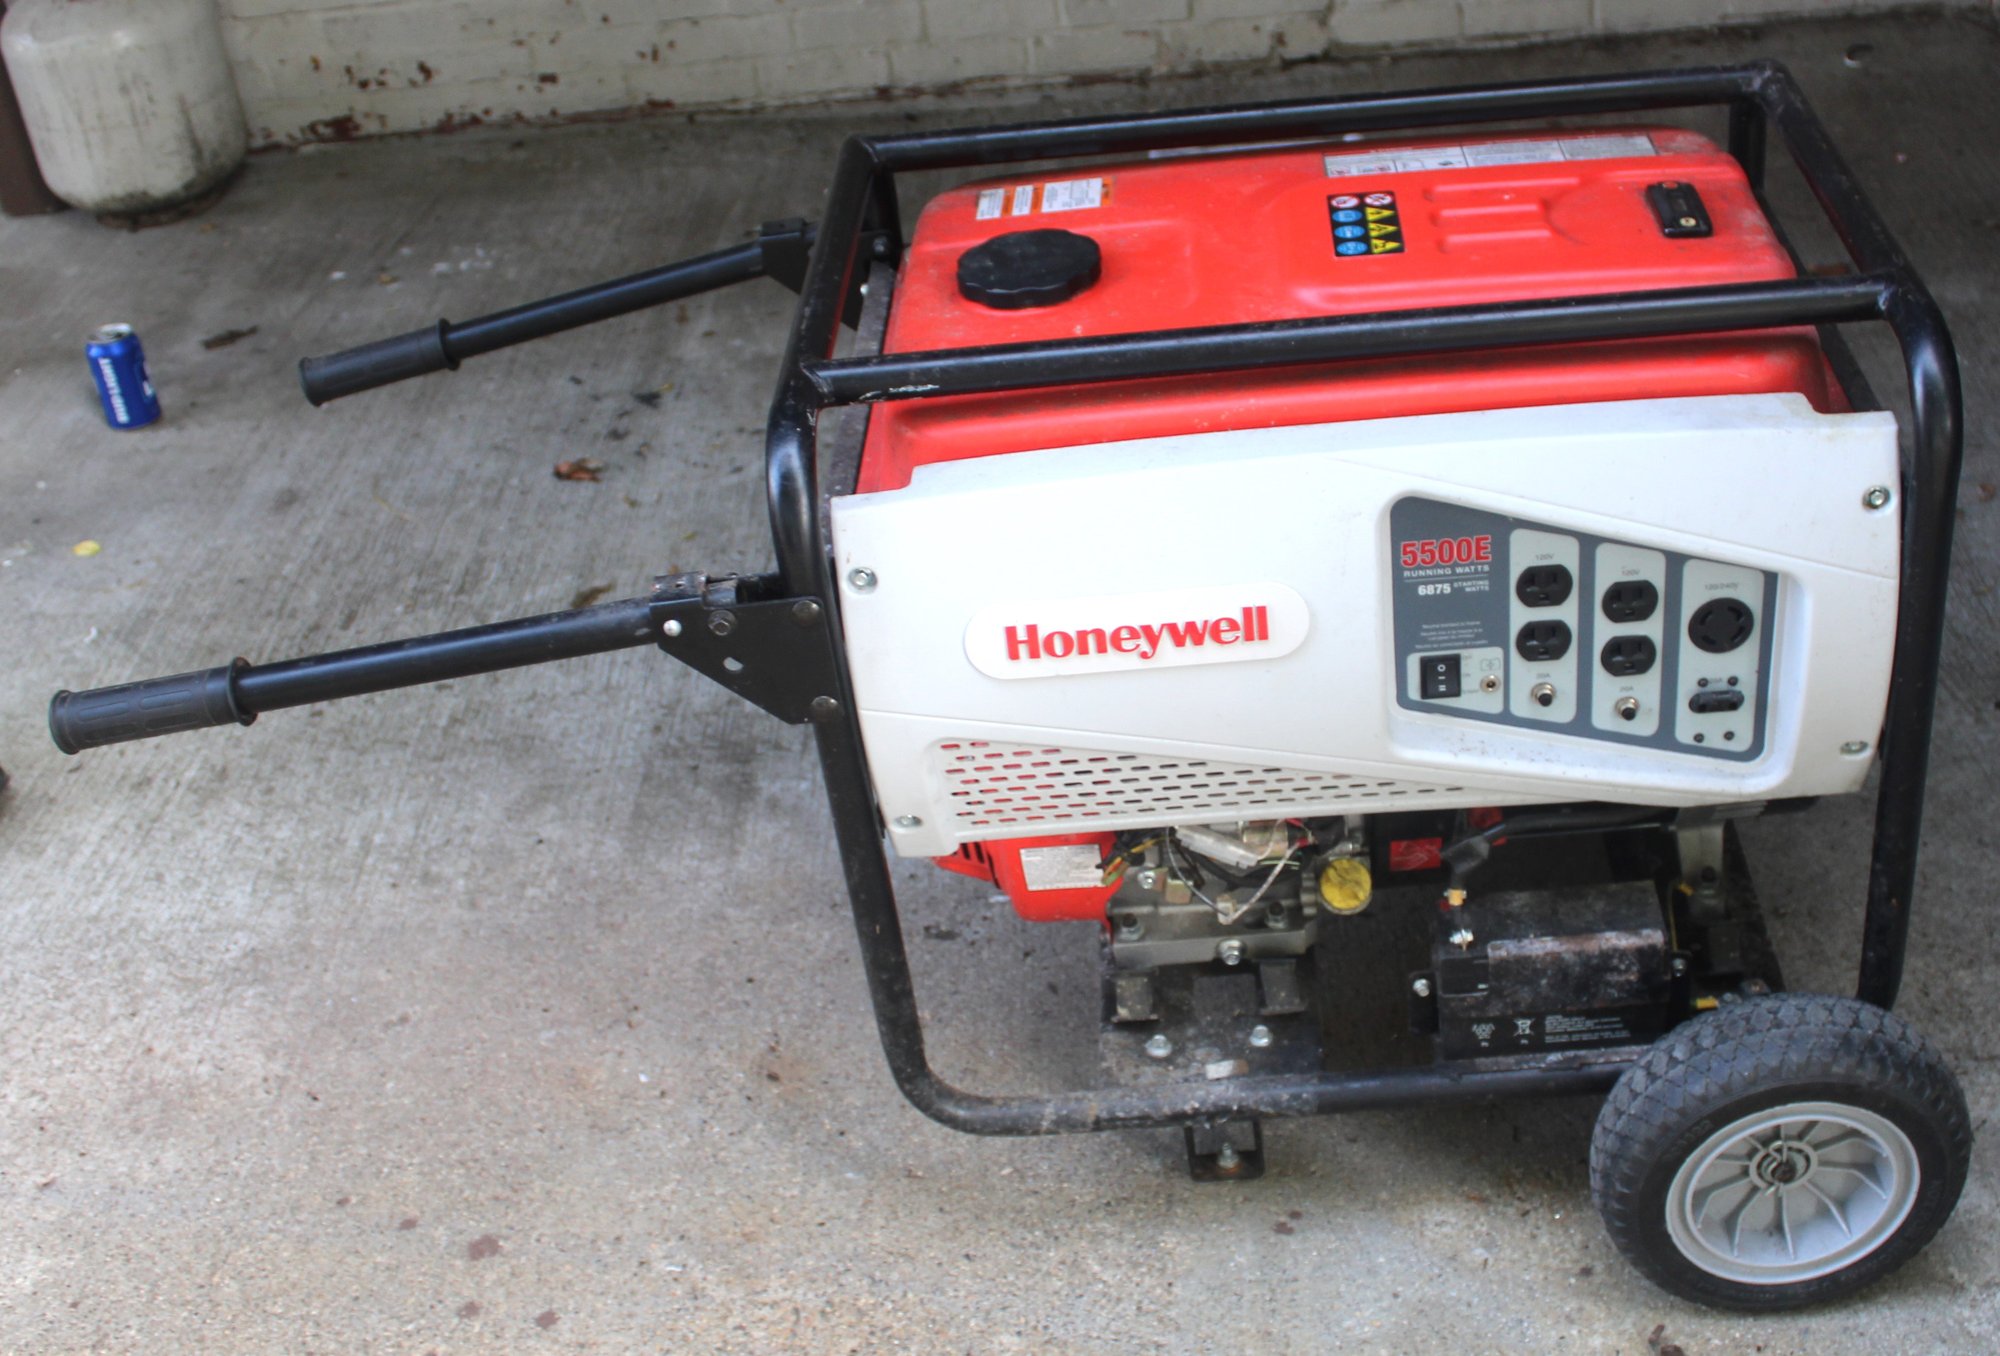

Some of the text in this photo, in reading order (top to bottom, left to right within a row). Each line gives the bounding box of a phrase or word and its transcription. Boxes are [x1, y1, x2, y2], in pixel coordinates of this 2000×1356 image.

[1401, 534, 1492, 568] 5500E
[1403, 564, 1490, 577] RUNNING WATTS
[1418, 583, 1451, 596] 6875
[1453, 580, 1489, 588] STARTING
[1004, 605, 1270, 661] Honeywell
